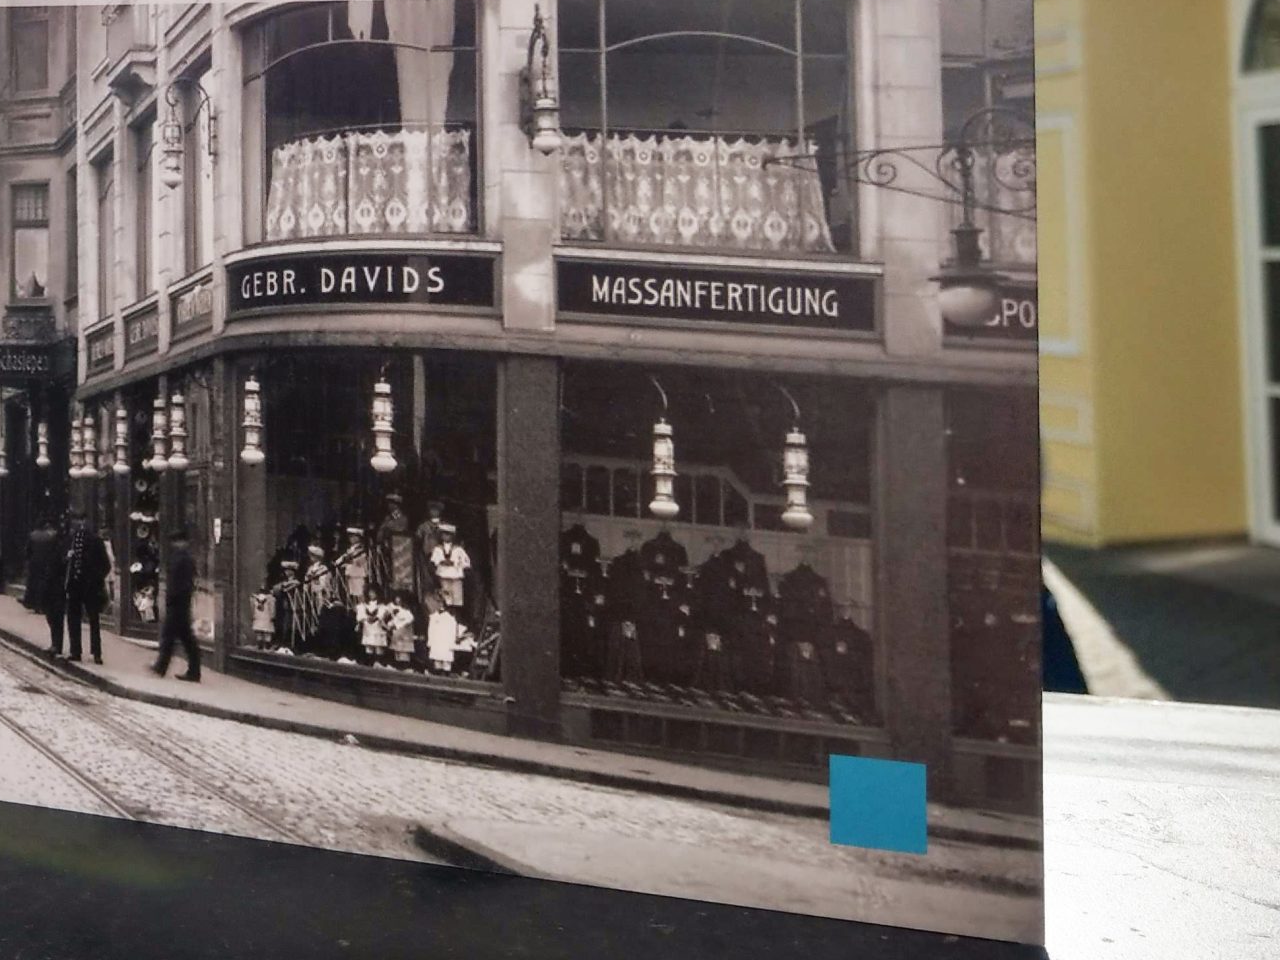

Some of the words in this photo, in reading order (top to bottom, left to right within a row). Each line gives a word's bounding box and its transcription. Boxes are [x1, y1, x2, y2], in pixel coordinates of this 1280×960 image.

[241, 269, 306, 299] GEBR.
[320, 265, 446, 293] DAVIDS
[591, 274, 839, 318] MASSANFERTIGUNG
